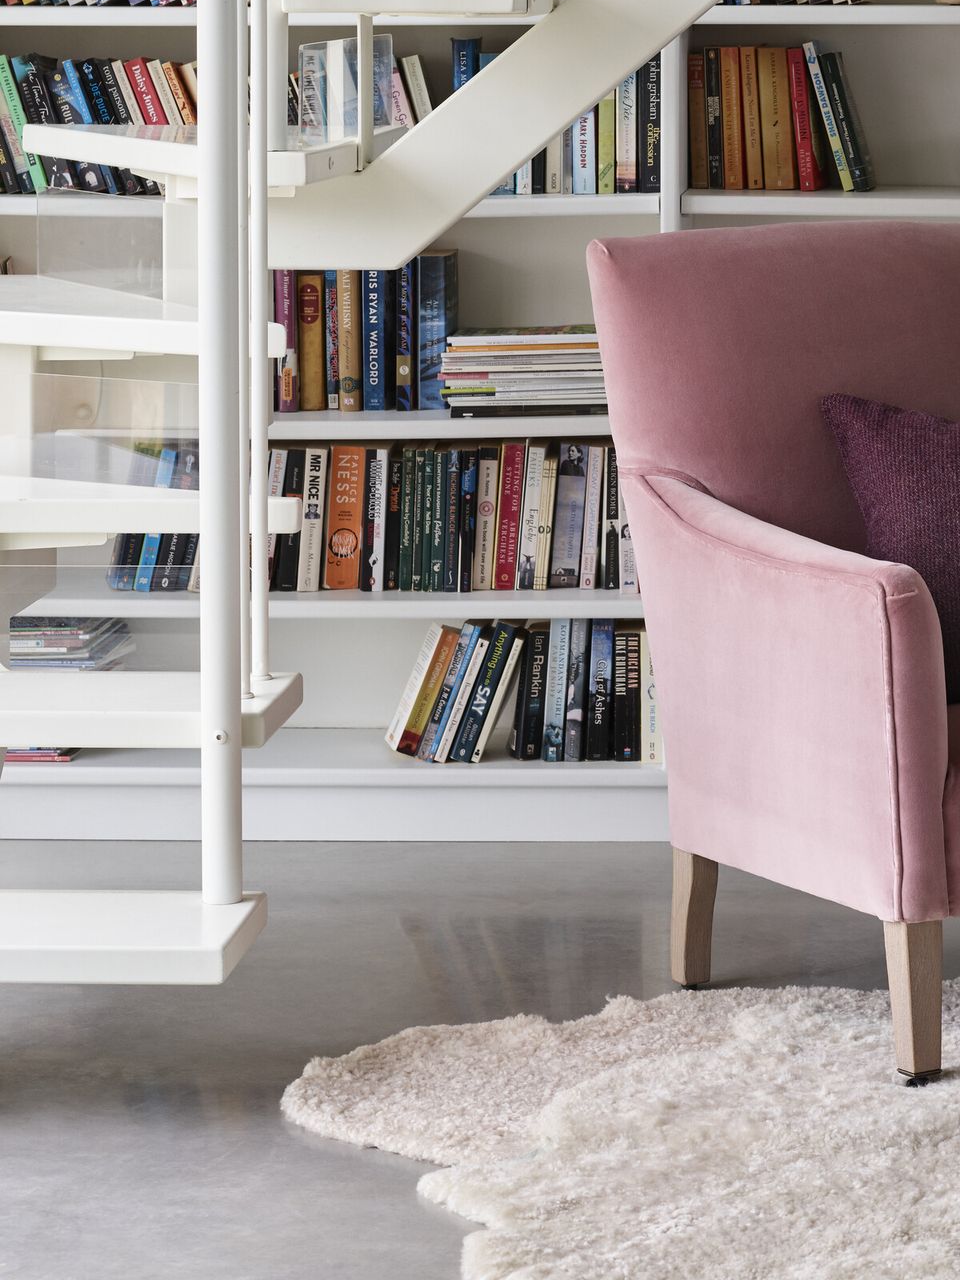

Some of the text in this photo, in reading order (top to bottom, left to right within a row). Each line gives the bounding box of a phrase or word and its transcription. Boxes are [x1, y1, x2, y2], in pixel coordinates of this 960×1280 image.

[103, 66, 128, 119] tony parsons
[132, 64, 158, 122] Daisy Jones
[648, 82, 660, 120] grisham
[813, 72, 836, 137] SHANE DAWSON
[580, 117, 588, 136] MARK
[368, 291, 379, 385] RYAN WARLORD
[308, 454, 321, 500] MR NICE
[336, 455, 350, 503] NESS
[349, 455, 359, 503] PATRICK
[499, 519, 508, 563] VERGHESE
[508, 522, 516, 563] ABRAHAM
[487, 631, 508, 669] Anything
[530, 654, 544, 697] Rankin
[472, 685, 490, 715] SAY
[594, 694, 607, 725] Ashes
